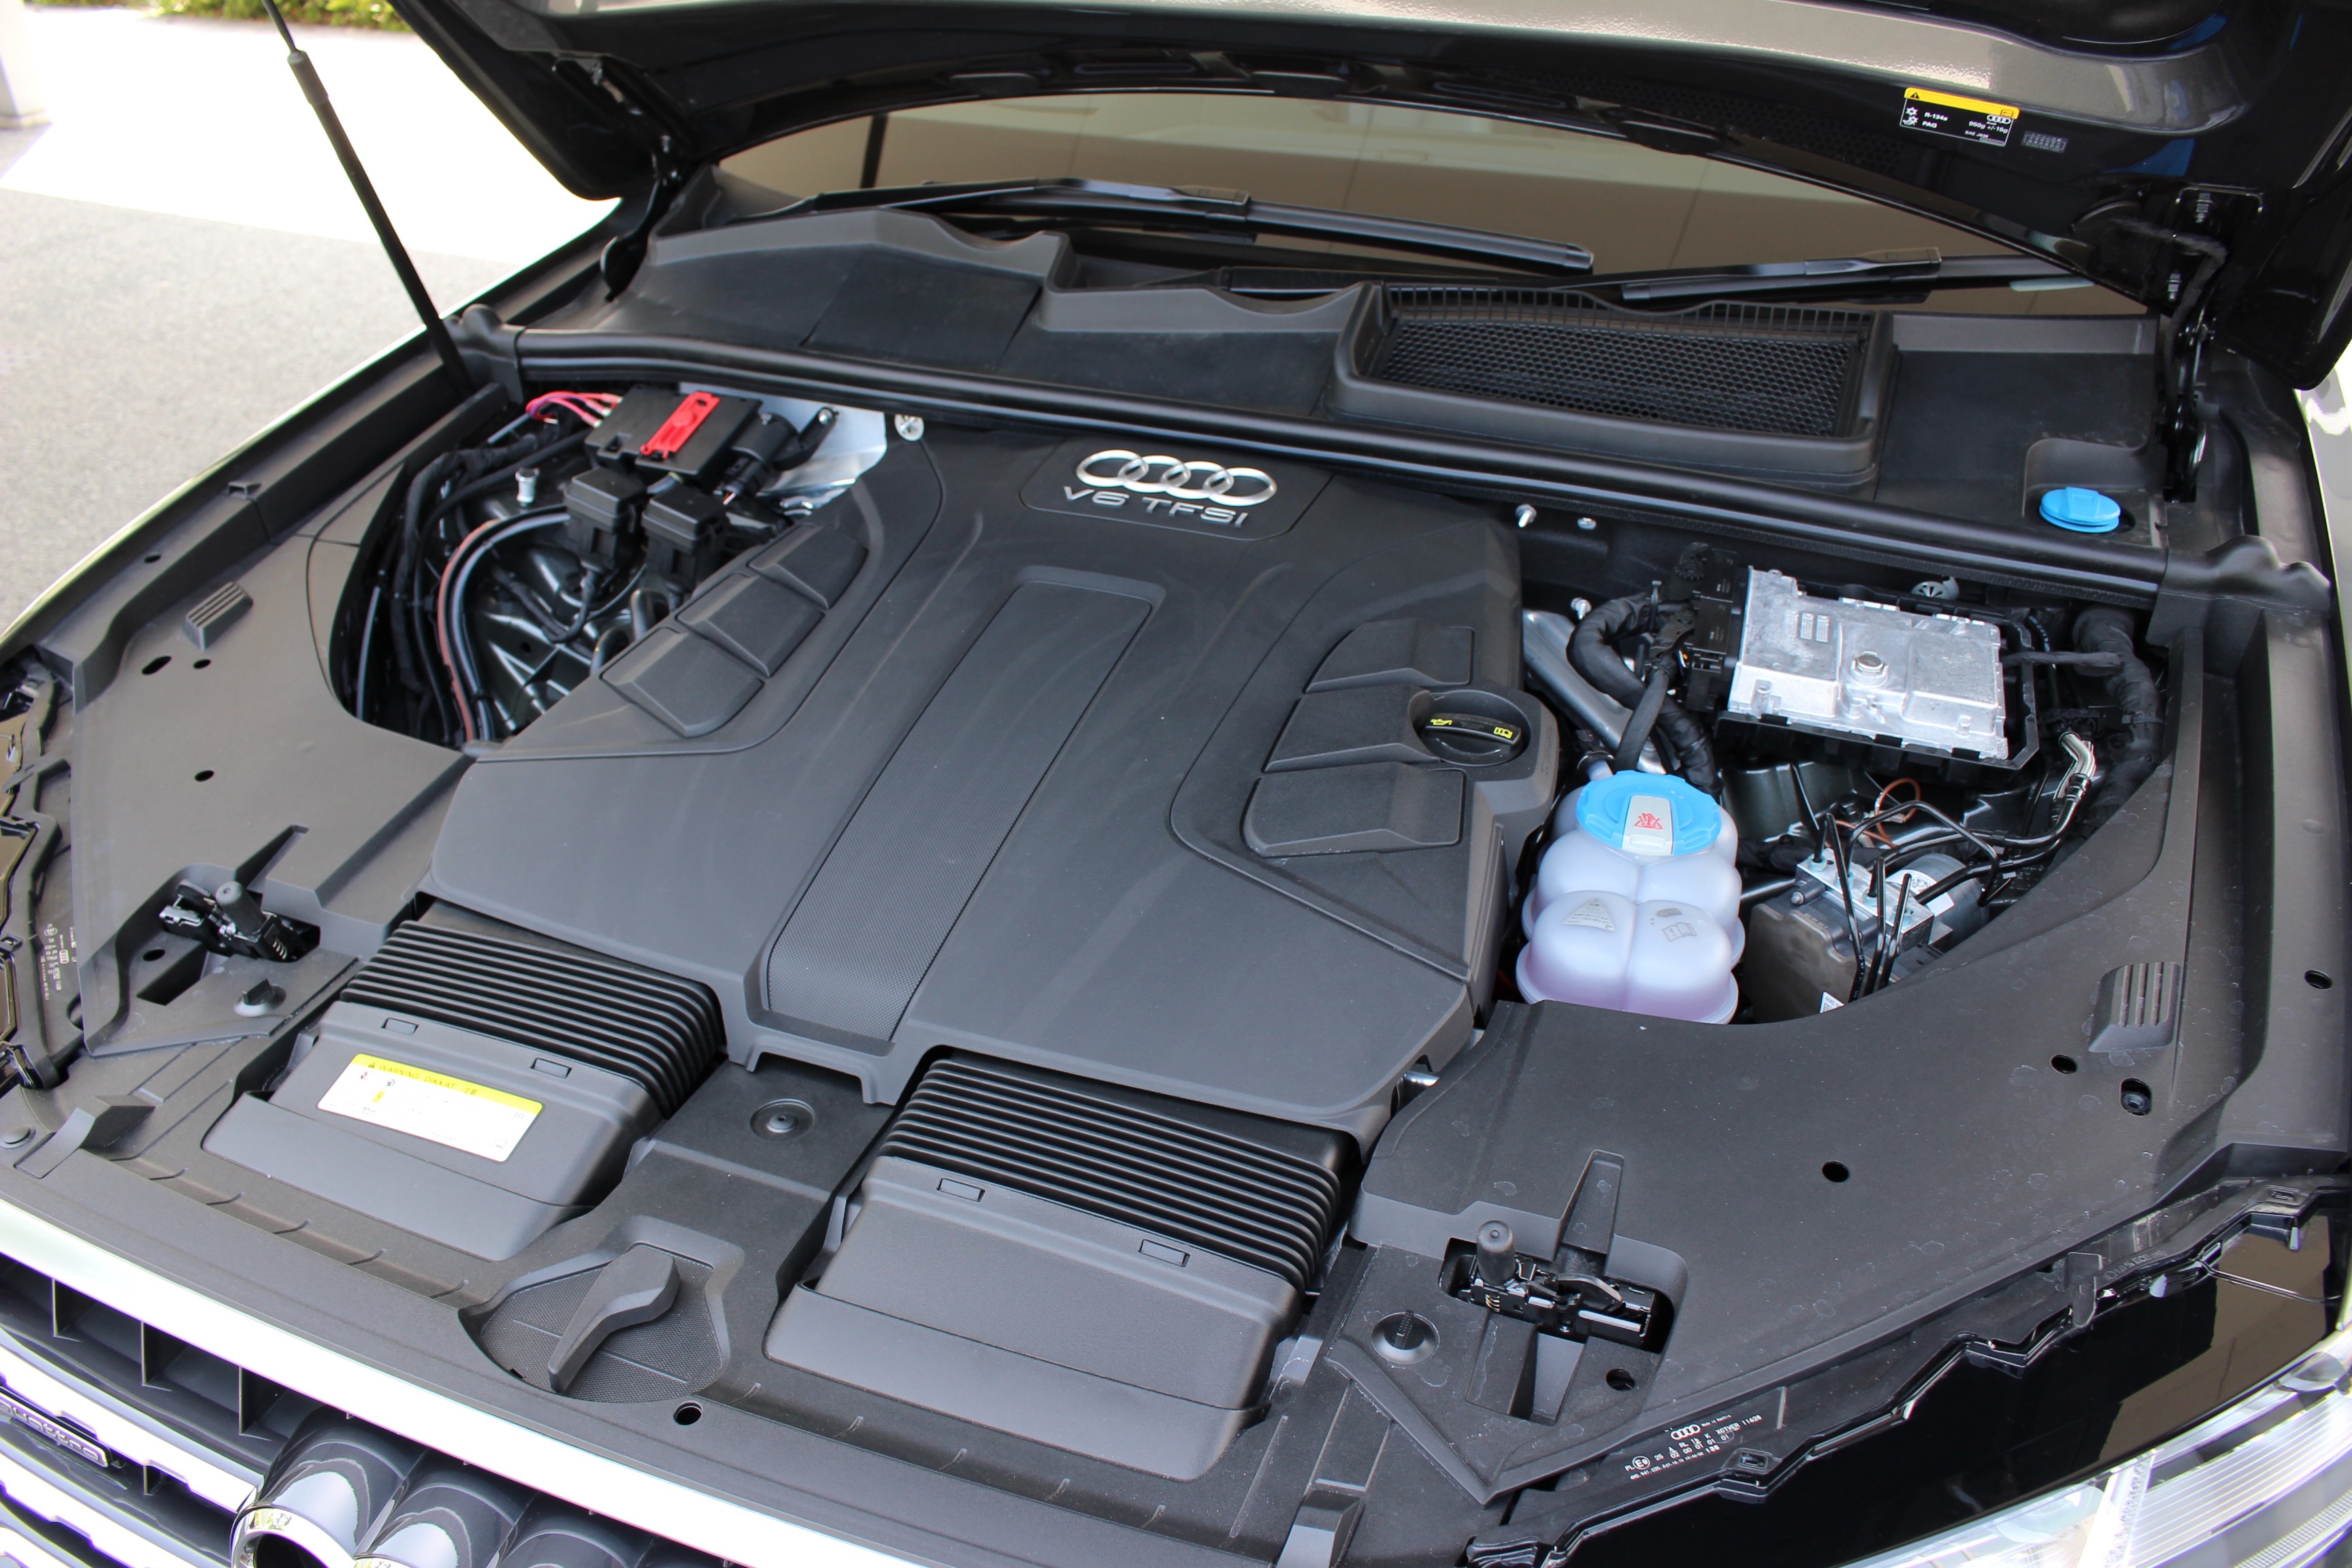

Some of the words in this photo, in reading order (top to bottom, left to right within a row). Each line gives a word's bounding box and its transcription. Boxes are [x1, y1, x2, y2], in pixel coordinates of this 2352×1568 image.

[1924, 112, 1948, 121] R-134a
[1922, 120, 1938, 129] PAG
[1968, 120, 1986, 130] 950g
[1064, 485, 1130, 507] V6
[1142, 497, 1249, 527] TFSI
[379, 1064, 420, 1080] WARNING
[424, 1076, 456, 1089] DIKKAT
[2132, 1254, 2151, 1264] ECE
[1635, 1458, 1648, 1468] E9
[1654, 1453, 1664, 1461] 25
